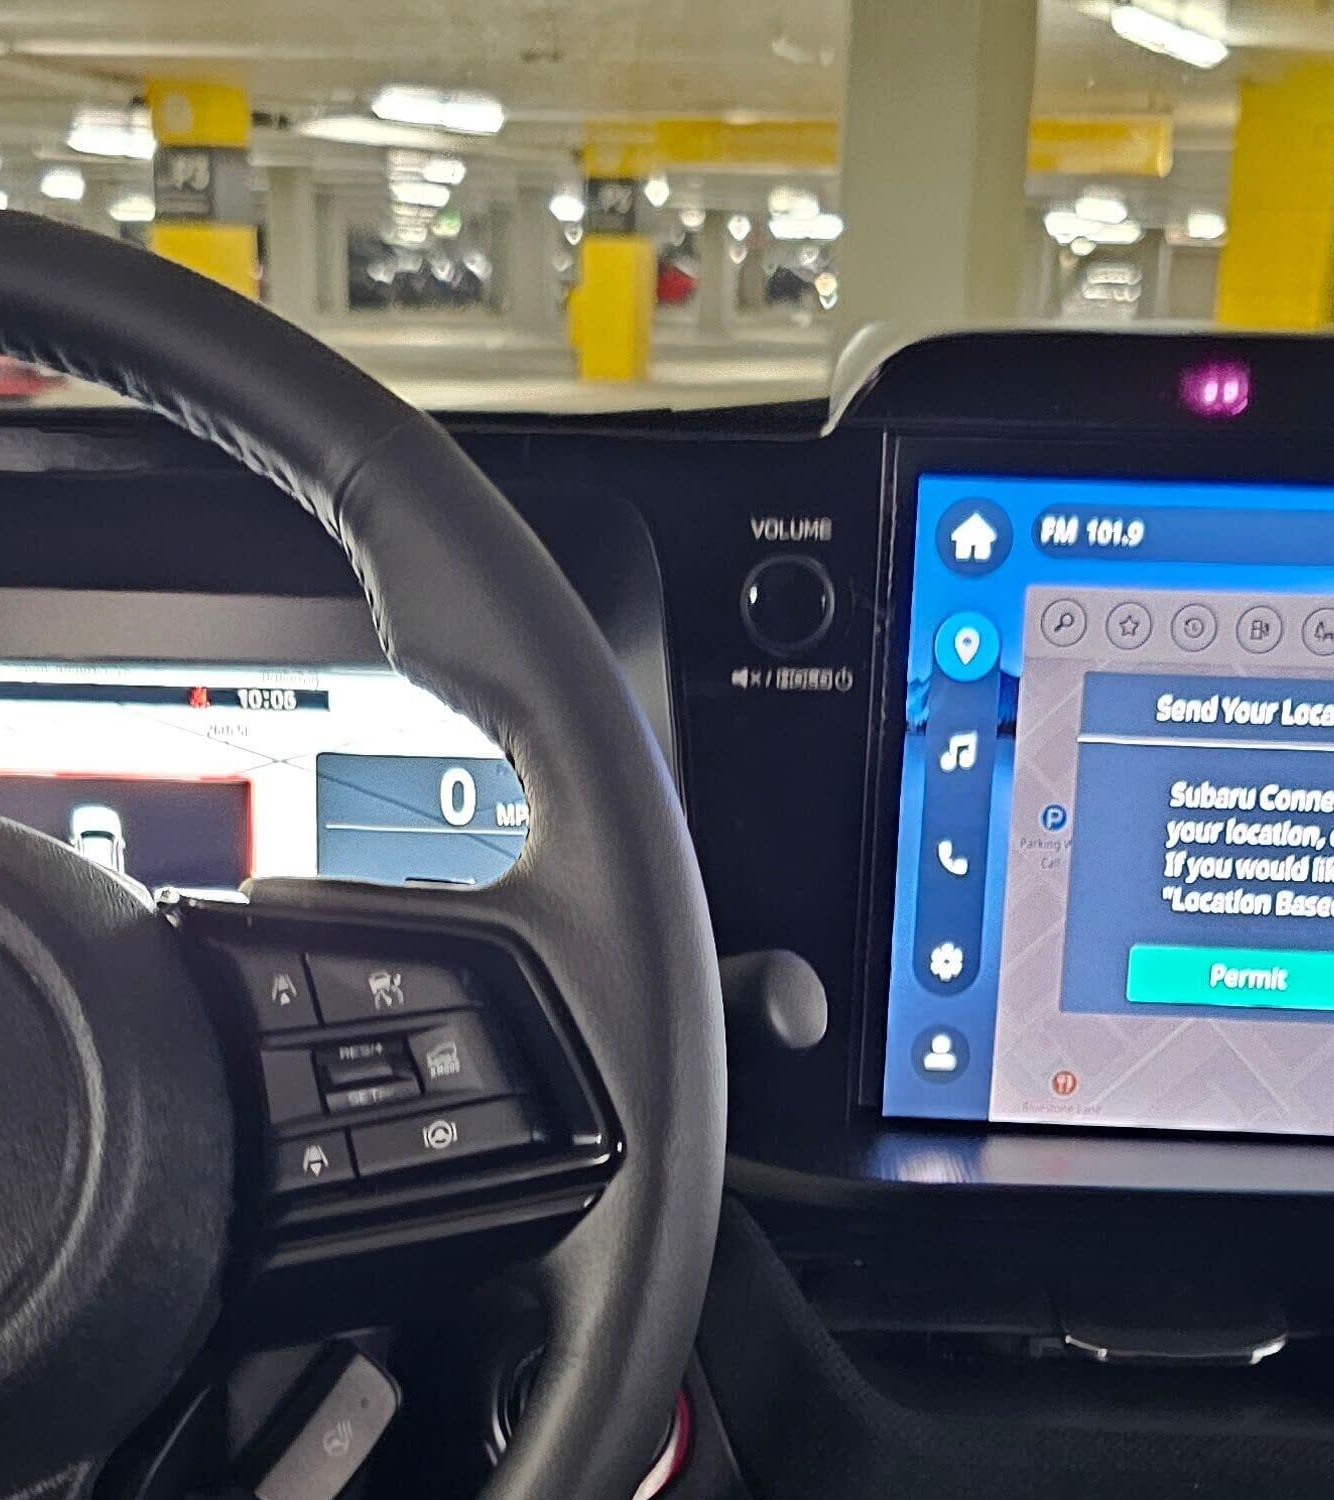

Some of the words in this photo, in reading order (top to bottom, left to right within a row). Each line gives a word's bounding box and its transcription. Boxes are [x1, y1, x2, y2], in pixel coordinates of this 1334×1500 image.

[751, 517, 832, 541] VOLUME
[1040, 515, 1079, 546] FM
[1087, 516, 1145, 548] 101.9
[1156, 694, 1218, 722] Send
[1221, 696, 1279, 725] Your
[440, 767, 477, 827] 0
[1170, 781, 1257, 810] Subaru
[496, 801, 531, 827] MP
[1166, 820, 1223, 848] your
[1225, 817, 1327, 850] location,
[1164, 850, 1187, 878] If
[1185, 856, 1233, 883] you
[1234, 855, 1310, 882] would
[1162, 886, 1272, 915] "Location
[1209, 963, 1288, 992] Permit
